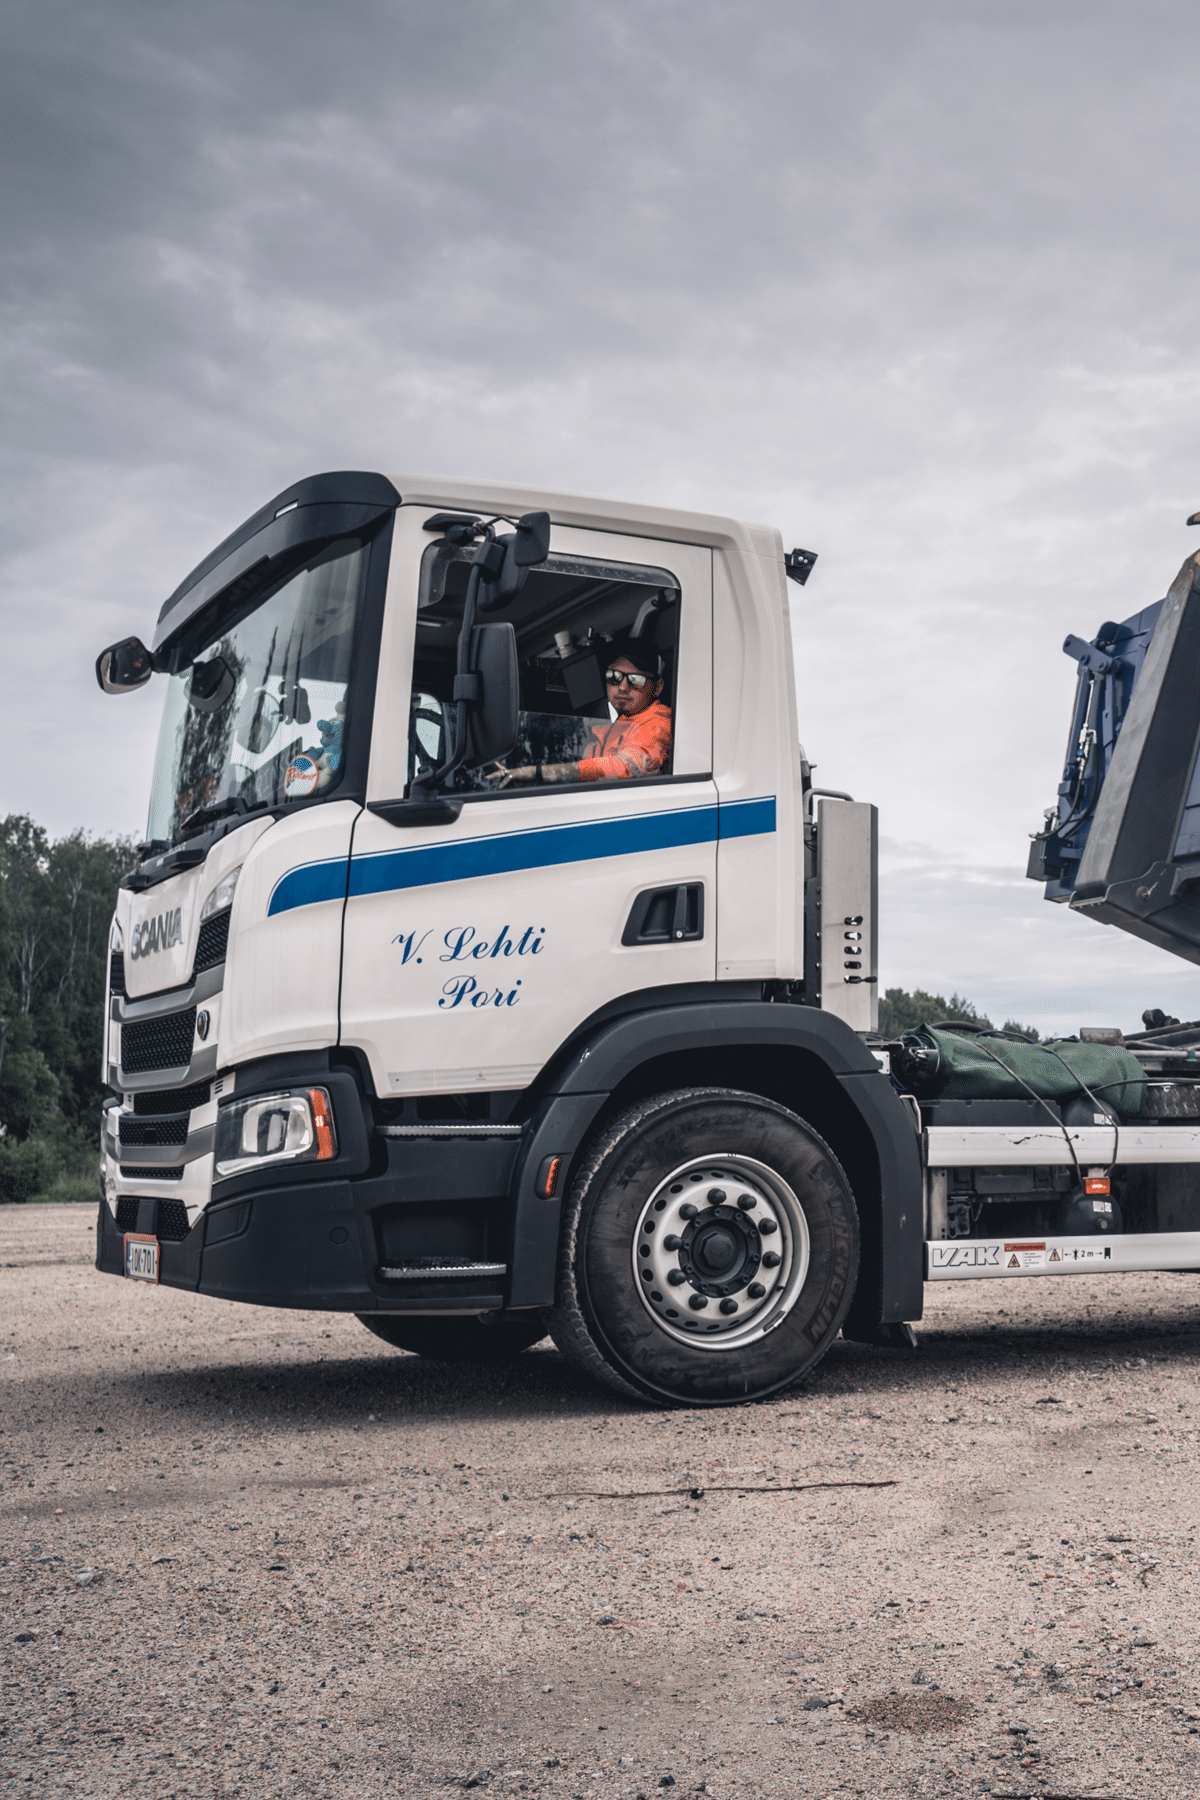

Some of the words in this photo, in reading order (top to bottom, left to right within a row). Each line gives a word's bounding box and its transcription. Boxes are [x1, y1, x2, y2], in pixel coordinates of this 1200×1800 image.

[130, 906, 184, 961] SCANIA
[391, 928, 434, 966] V.
[439, 925, 546, 962] Lehti
[438, 975, 522, 1009] Pori
[932, 1245, 1000, 1268] VAK
[1080, 1249, 1086, 1258] 2
[1087, 1250, 1094, 1258] m
